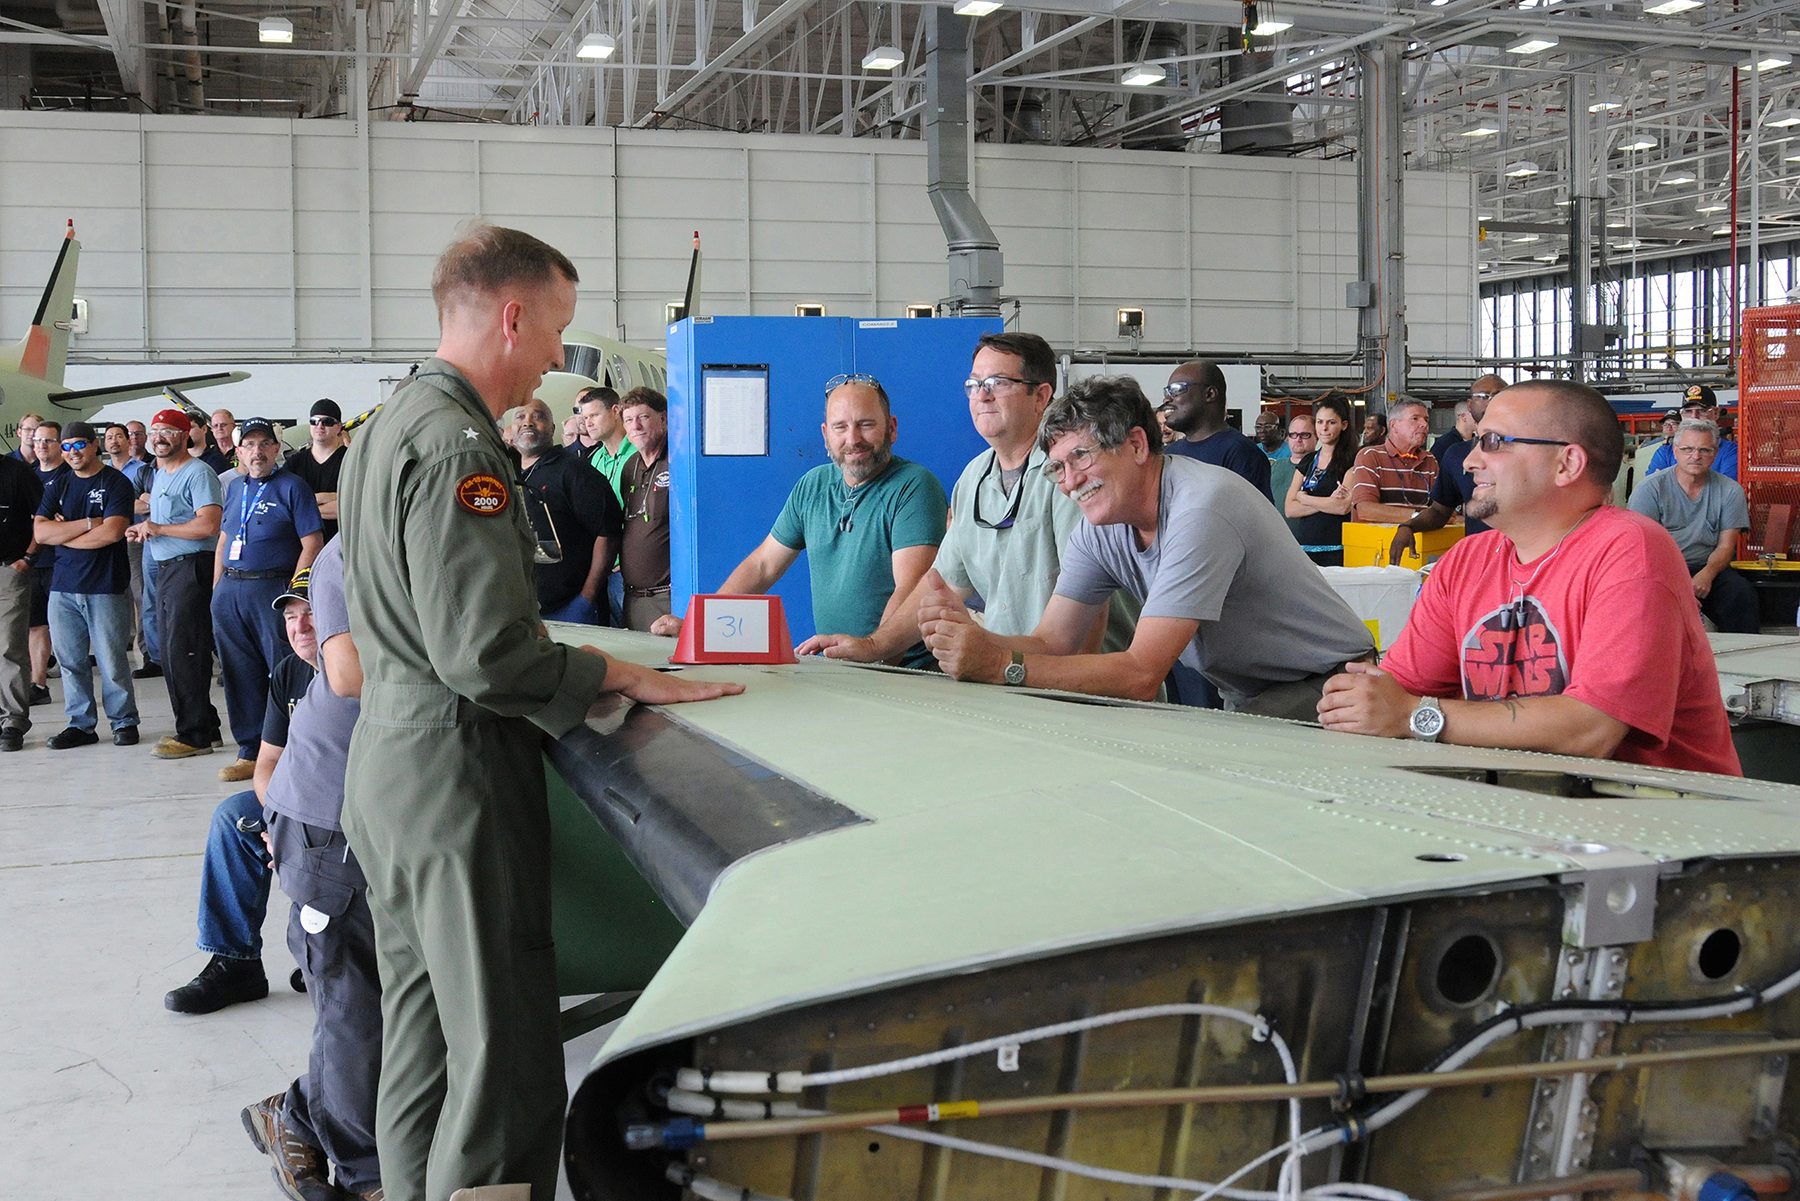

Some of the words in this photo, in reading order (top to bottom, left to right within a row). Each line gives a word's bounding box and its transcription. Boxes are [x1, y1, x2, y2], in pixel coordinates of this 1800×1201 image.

[474, 497, 498, 506] 2000
[717, 615, 743, 638] 31
[1465, 623, 1557, 665] STAR
[1464, 657, 1557, 699] WARS
